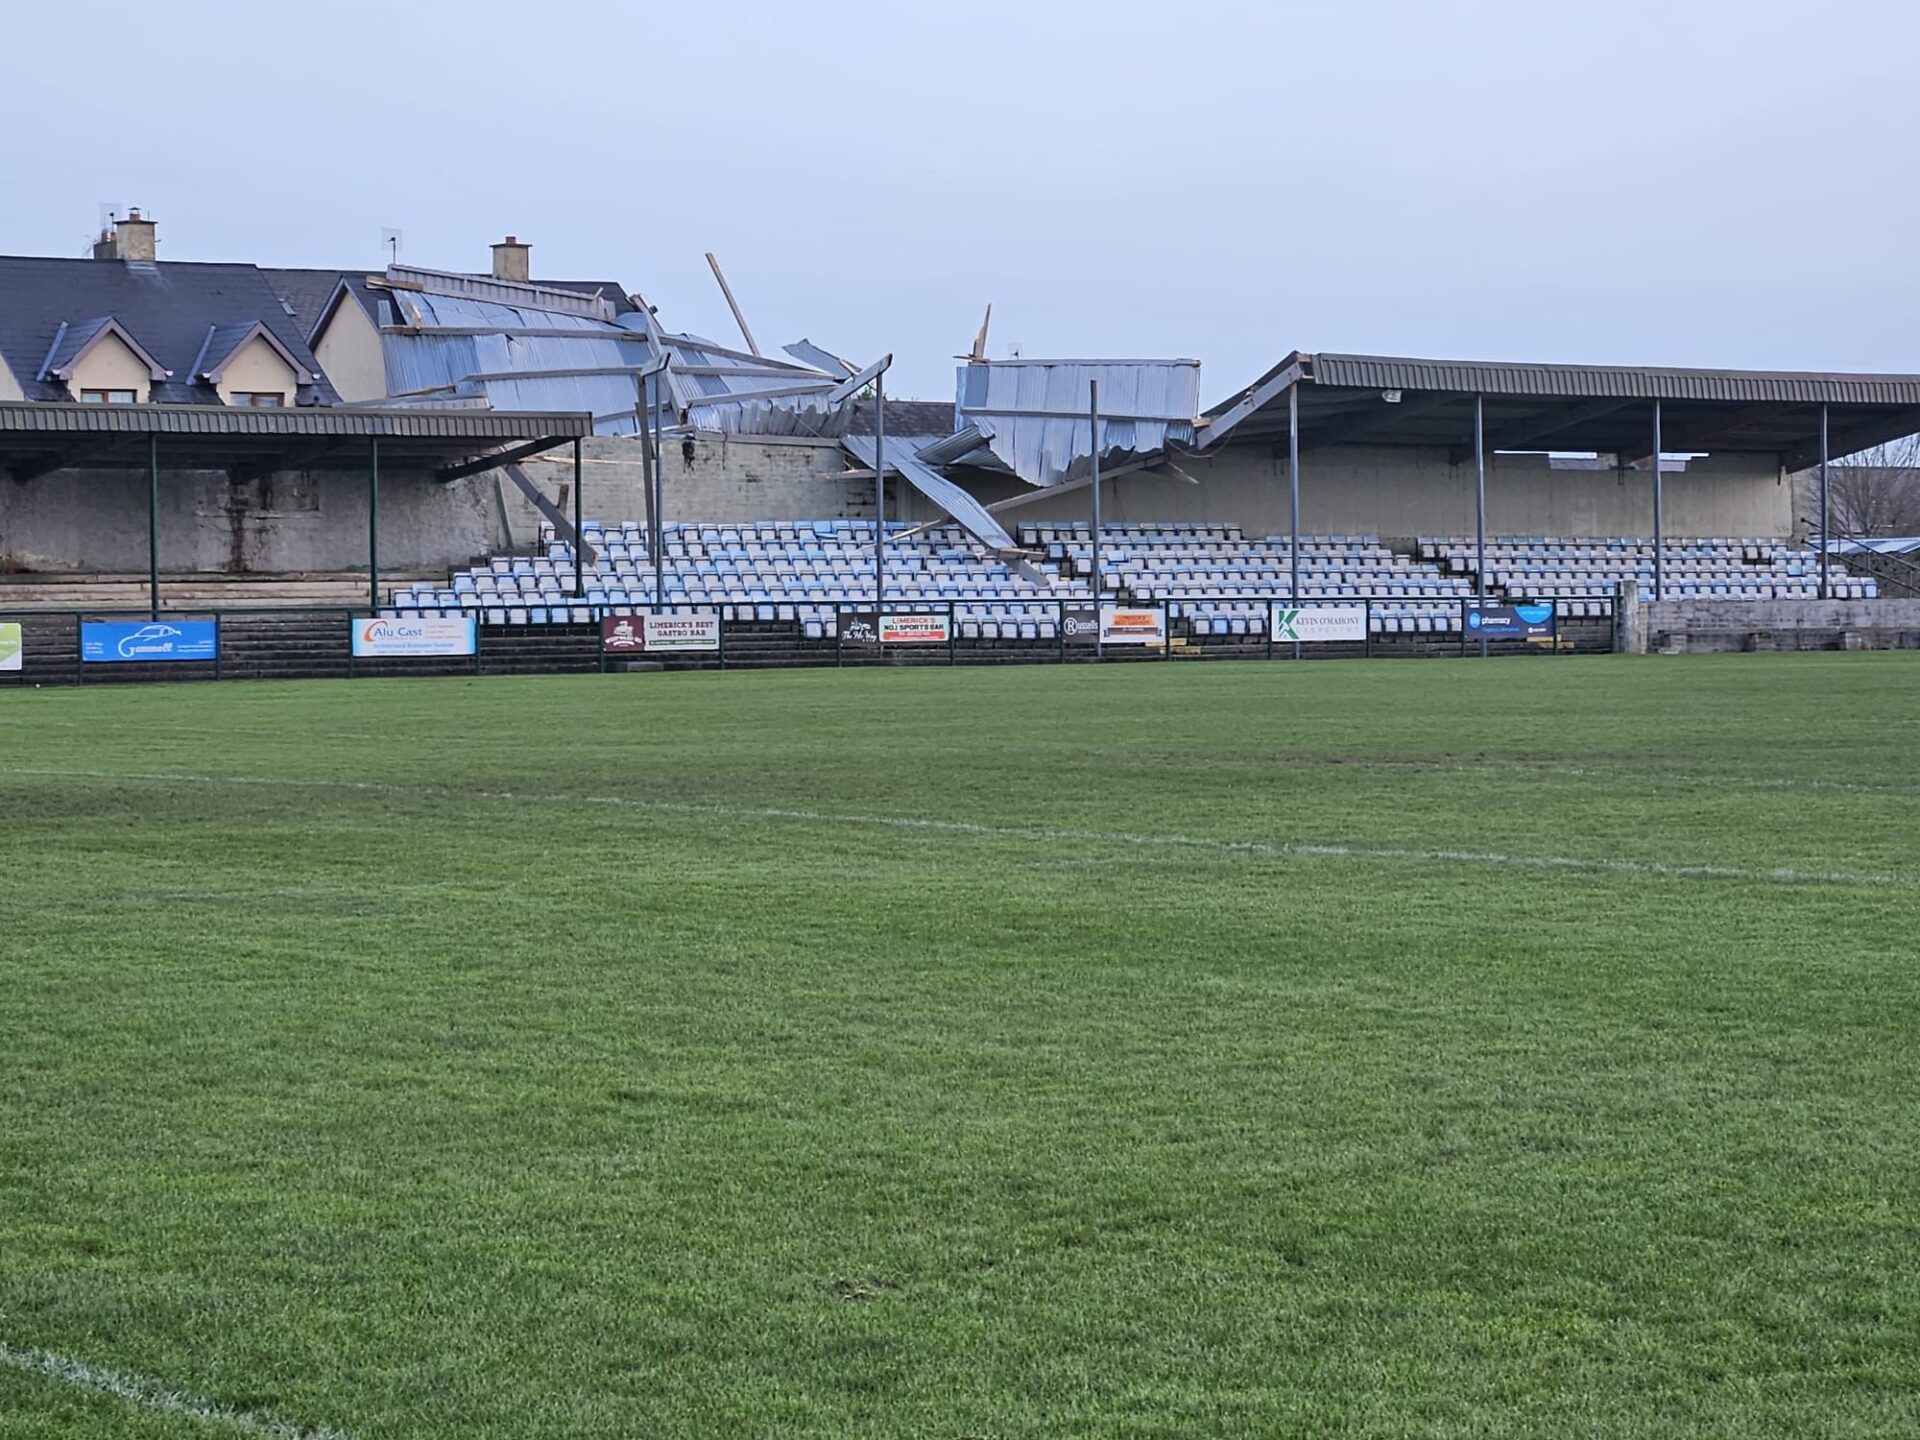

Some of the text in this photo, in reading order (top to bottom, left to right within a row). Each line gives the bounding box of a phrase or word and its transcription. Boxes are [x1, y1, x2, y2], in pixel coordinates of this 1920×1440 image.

[649, 621, 693, 629] LIMERICK'S
[1296, 617, 1359, 625] KEVIN O'MAHONY
[1065, 619, 1098, 633] Russells
[374, 627, 422, 637] Alu Cast
[657, 629, 688, 637] GASTRO
